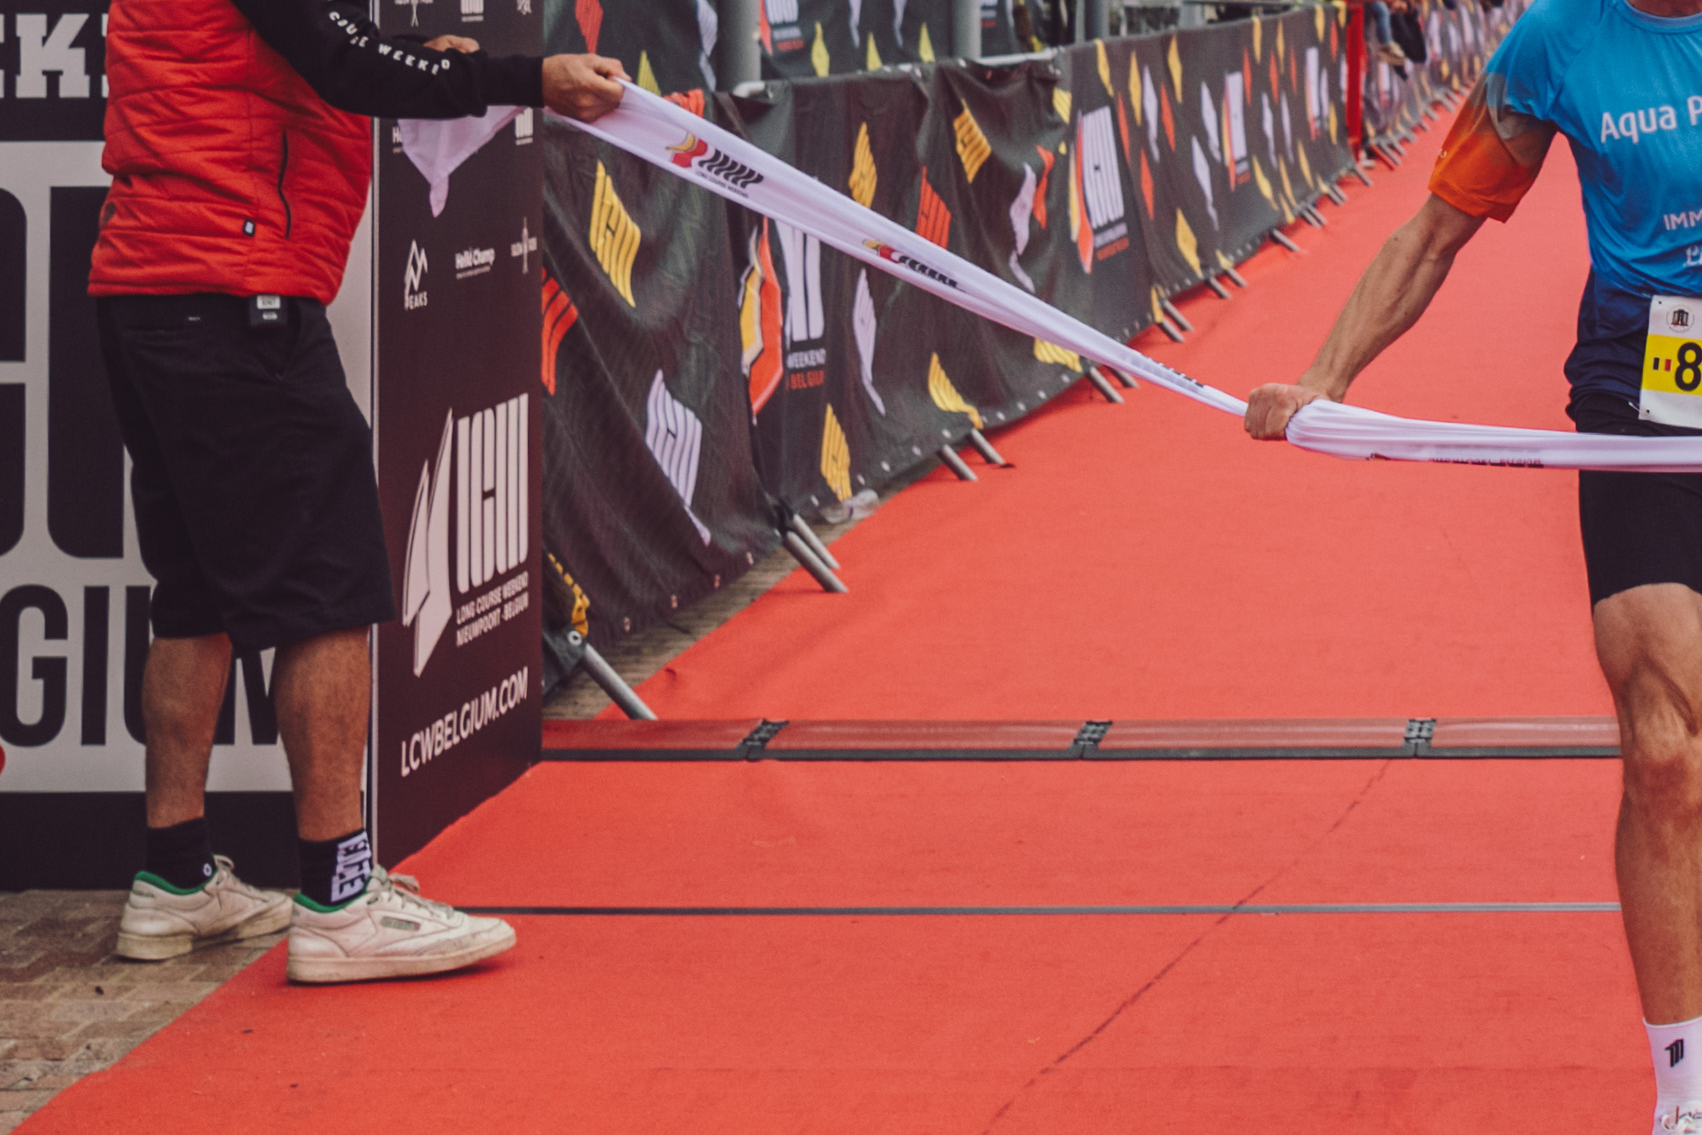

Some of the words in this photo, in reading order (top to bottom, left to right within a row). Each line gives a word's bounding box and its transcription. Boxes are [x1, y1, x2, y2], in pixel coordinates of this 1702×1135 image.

[1600, 105, 1679, 145] Aqua
[404, 292, 428, 311] PEAKS
[456, 600, 475, 625] LONG
[476, 585, 502, 615] COURSE
[502, 570, 529, 600] WEEKEND
[456, 607, 501, 648] NIEUWPOORT
[400, 666, 529, 777] LCWBELGIUM.COM
